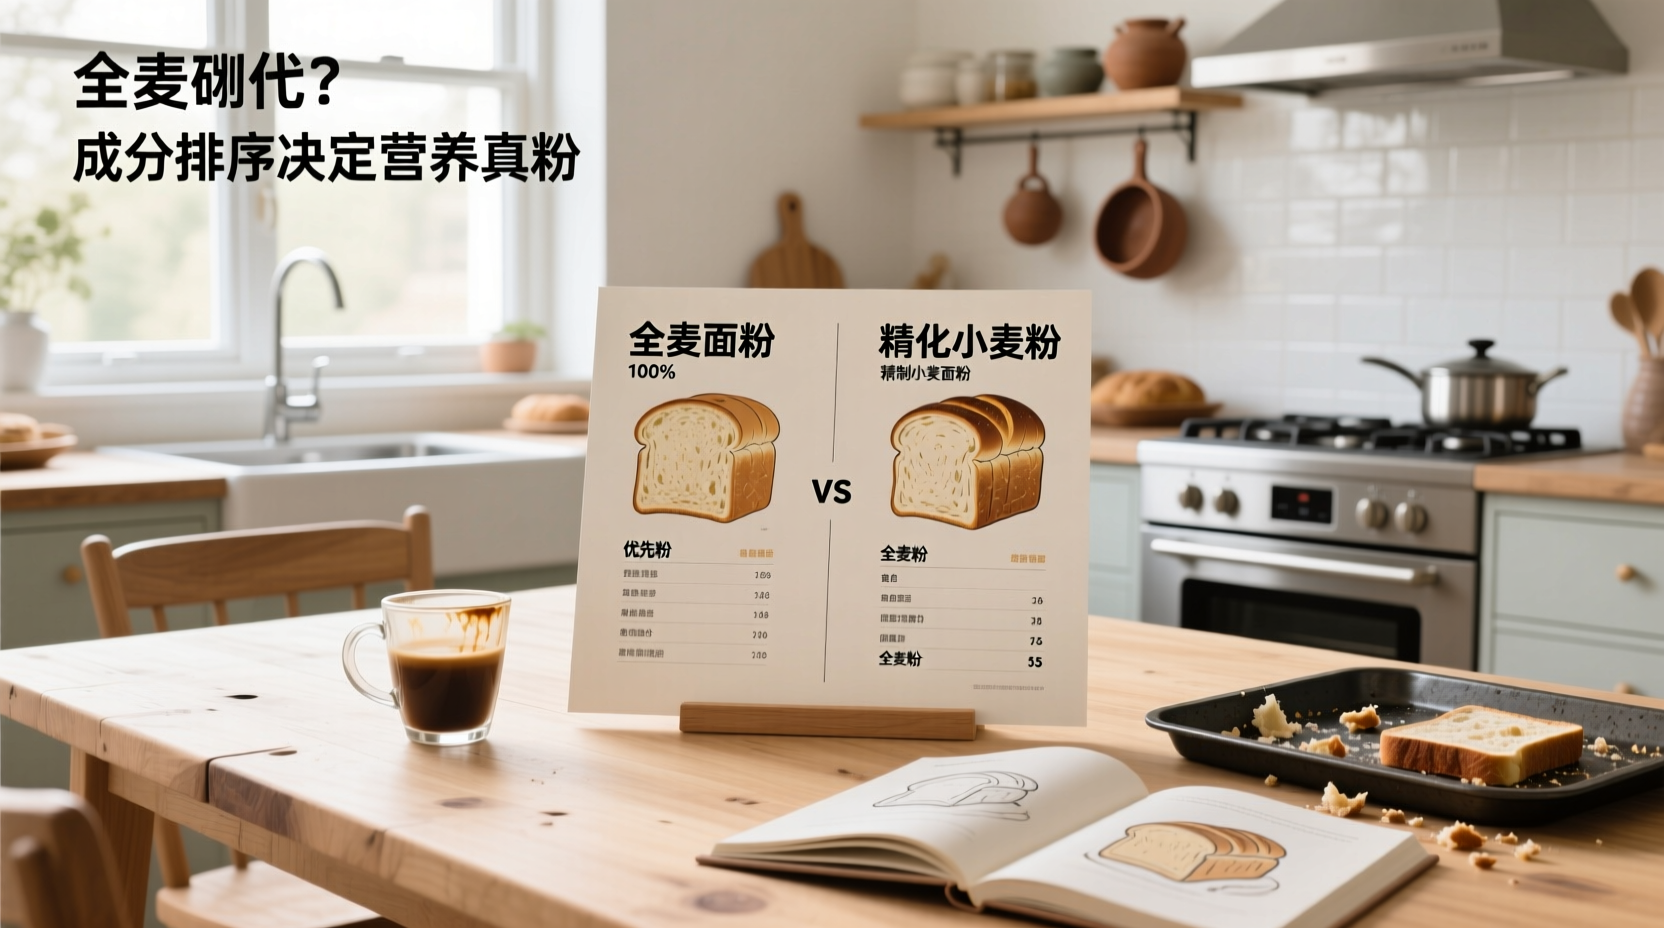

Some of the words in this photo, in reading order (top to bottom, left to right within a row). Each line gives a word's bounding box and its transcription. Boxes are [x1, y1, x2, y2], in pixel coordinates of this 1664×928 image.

[629, 320, 776, 359] 全麦面粉
[878, 322, 1062, 361] 精化小麦粉
[628, 363, 676, 380] 100%
[811, 479, 852, 505] VS
[623, 540, 672, 559] 优先粉
[880, 544, 928, 563] 全麦粉
[878, 650, 923, 667] 全麦粉
[1027, 656, 1043, 668] 55
